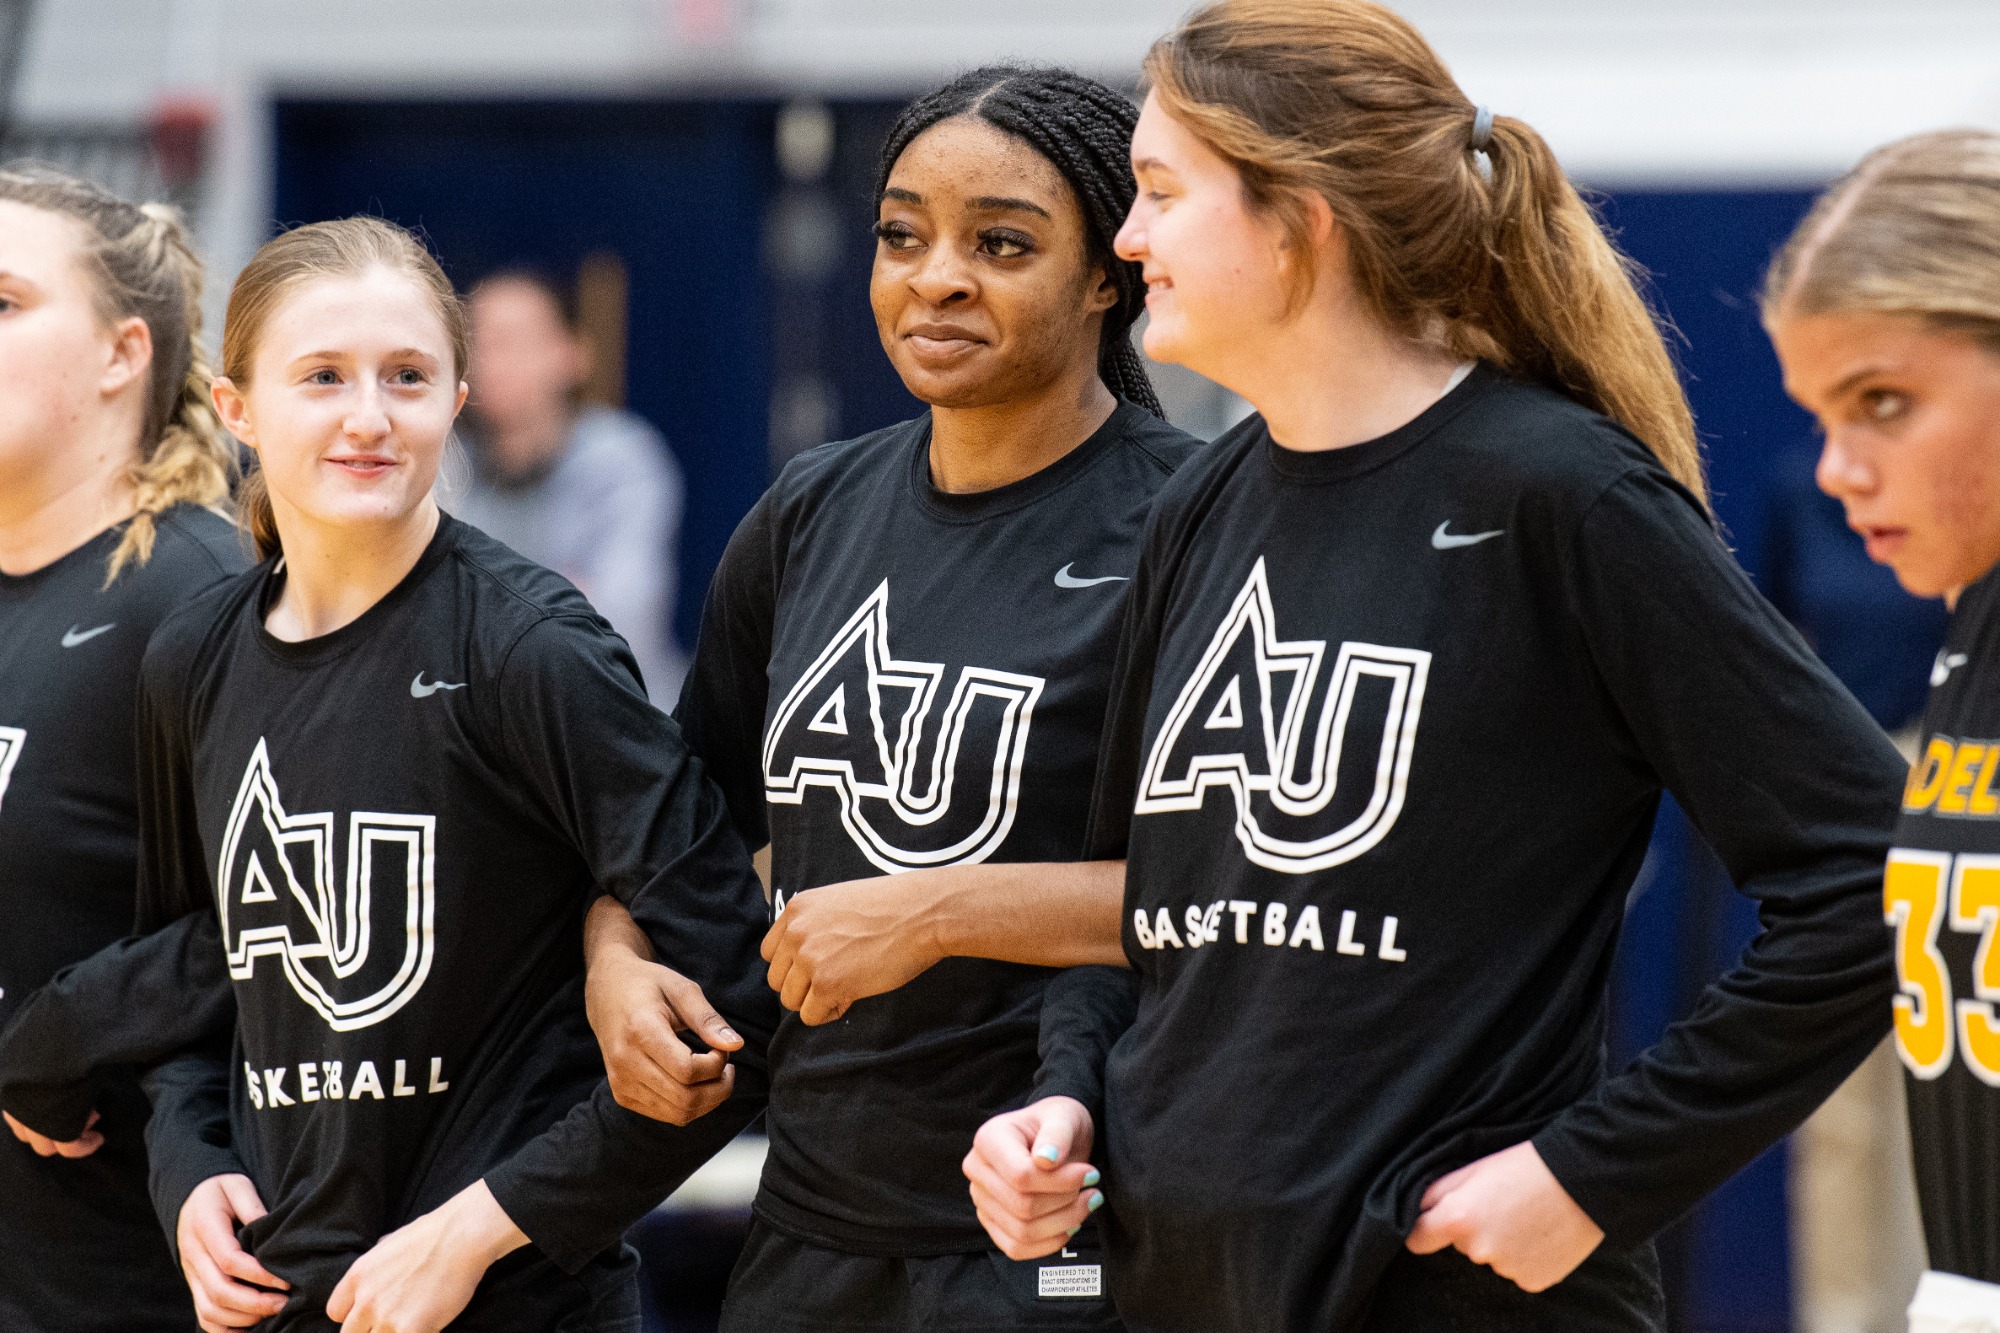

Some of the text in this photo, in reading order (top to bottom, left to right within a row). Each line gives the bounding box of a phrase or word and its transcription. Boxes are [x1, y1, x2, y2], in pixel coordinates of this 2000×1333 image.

[761, 578, 1045, 875] AU
[1134, 556, 1432, 874] AU
[218, 736, 436, 1031] AU
[1884, 848, 2000, 1086] 33
